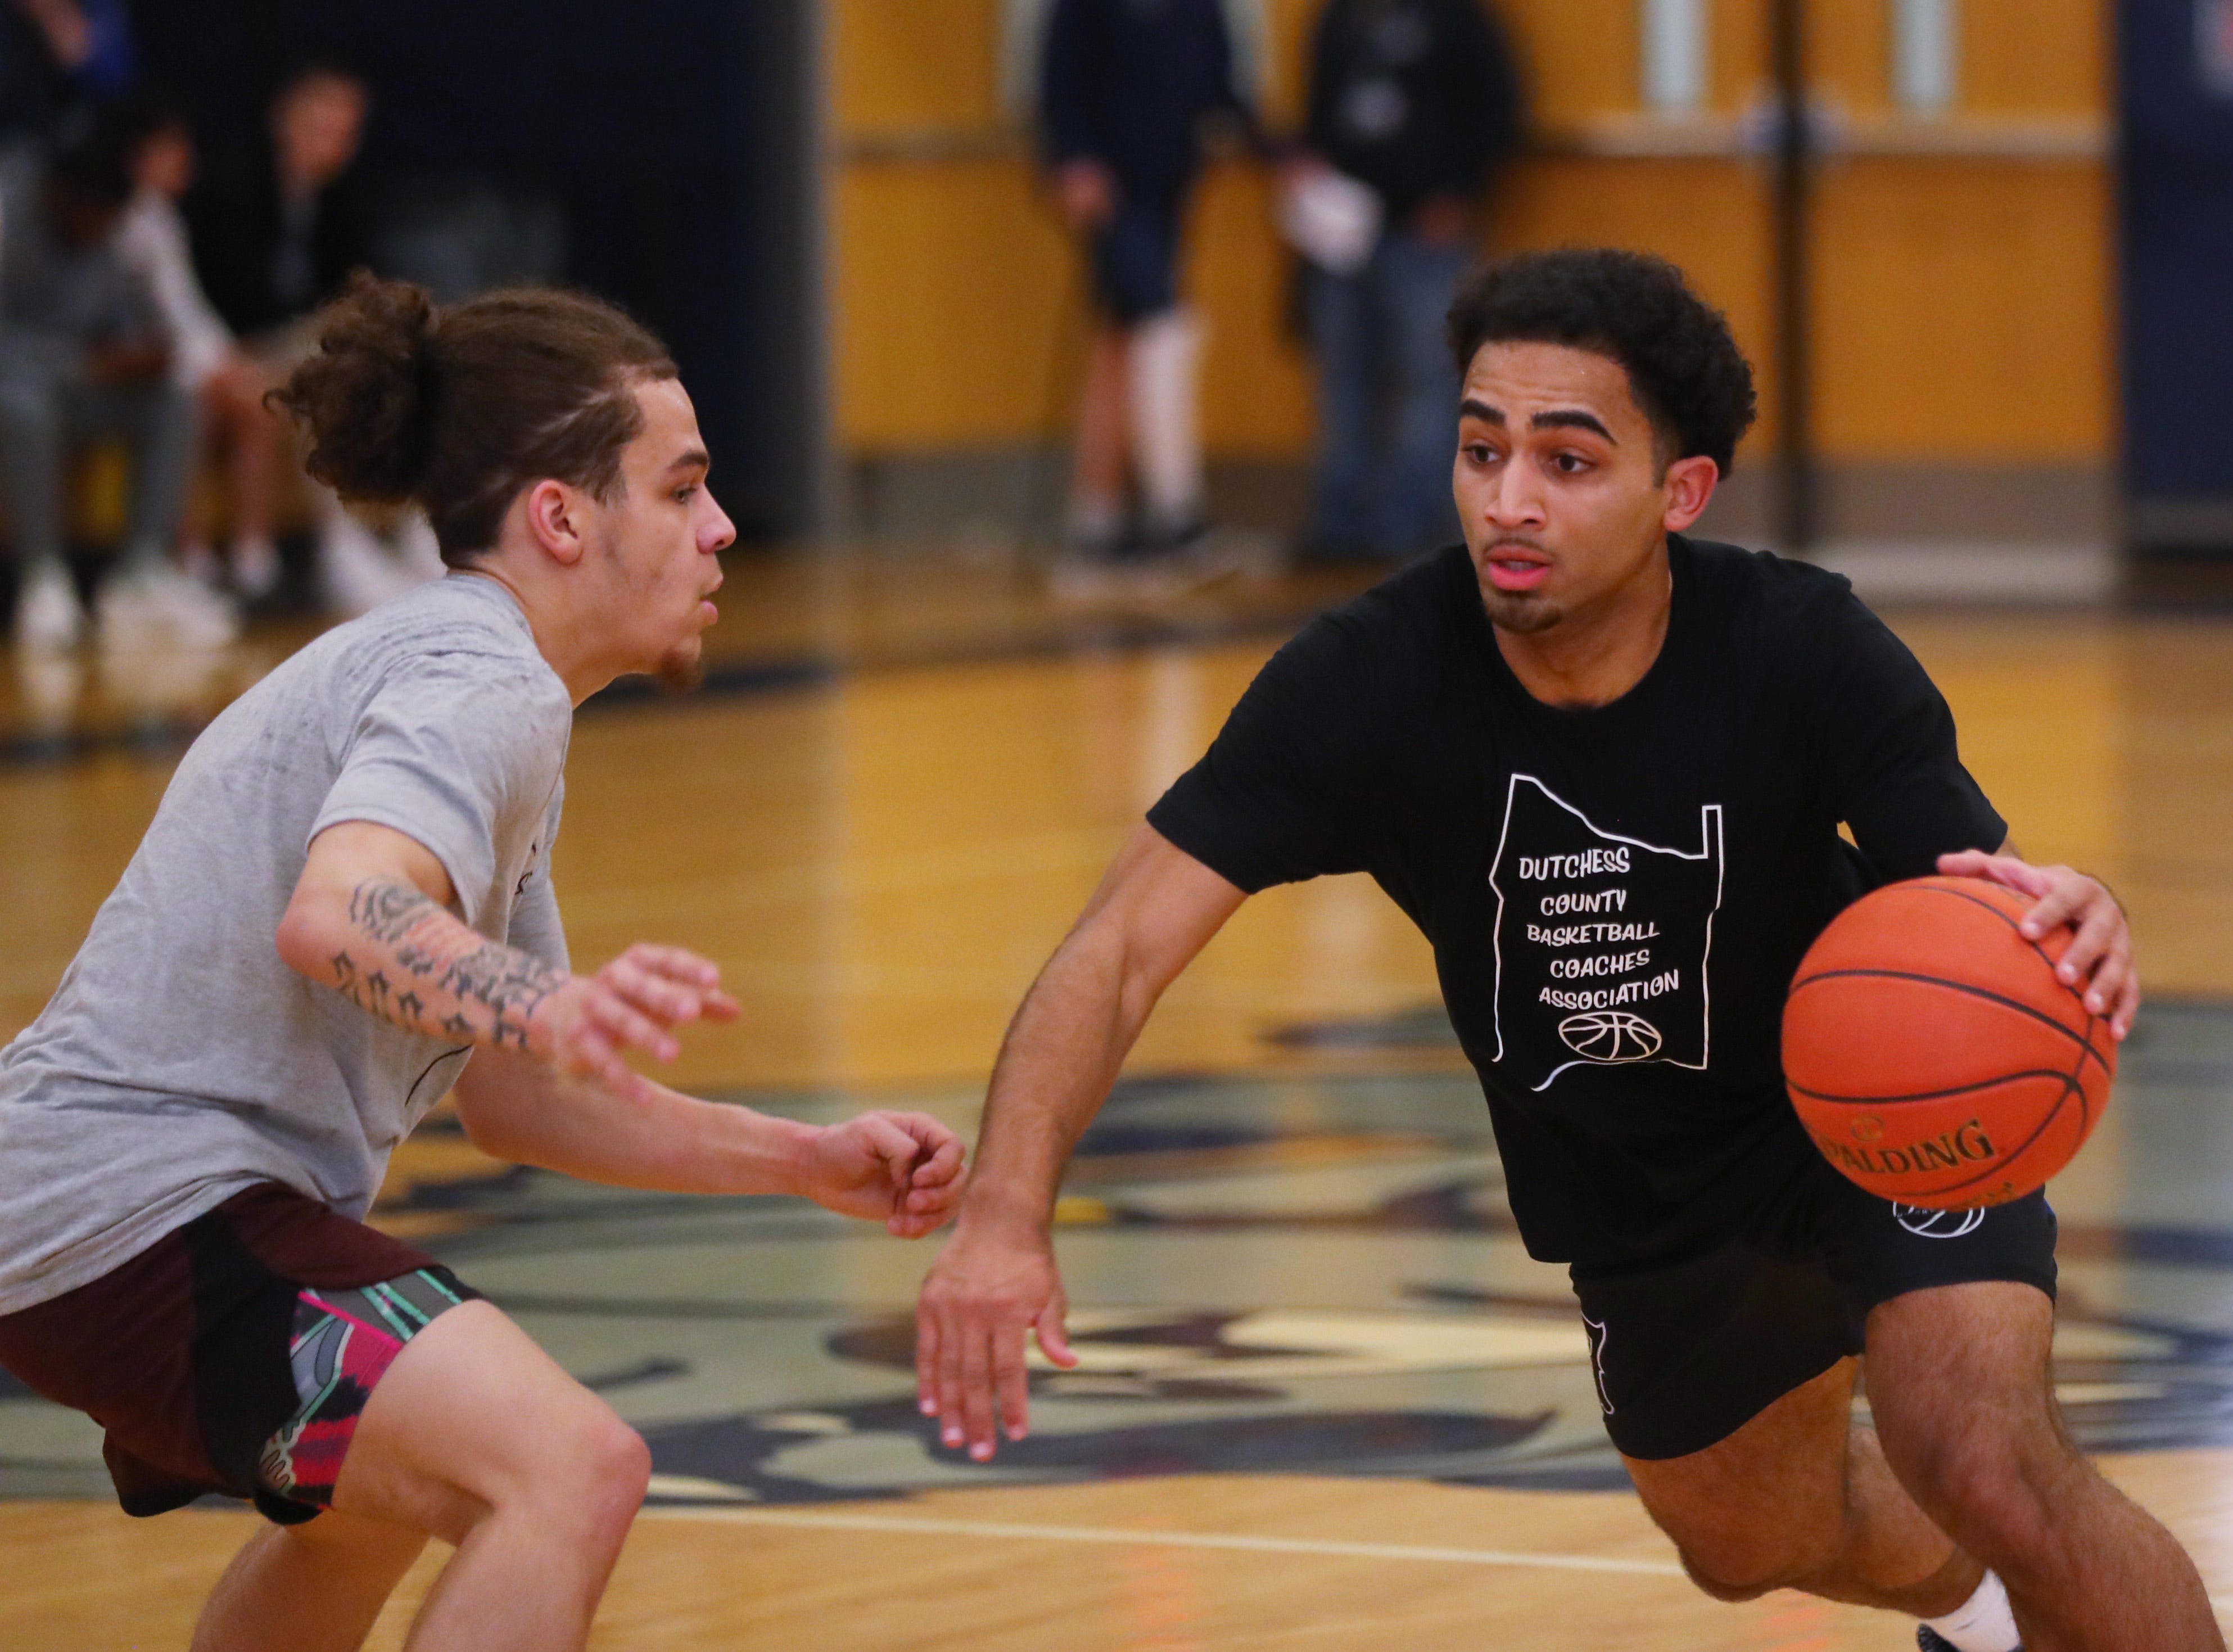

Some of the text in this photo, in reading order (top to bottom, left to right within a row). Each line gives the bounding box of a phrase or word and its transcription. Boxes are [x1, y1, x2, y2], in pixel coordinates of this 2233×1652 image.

[1519, 846, 1631, 881] DUTCHESS
[1540, 889, 1627, 916] COUNTY
[1526, 921, 1660, 947] BASKETBALL
[1549, 948, 1650, 979] COACHES
[1539, 968, 1679, 1010] ASSOCIATION
